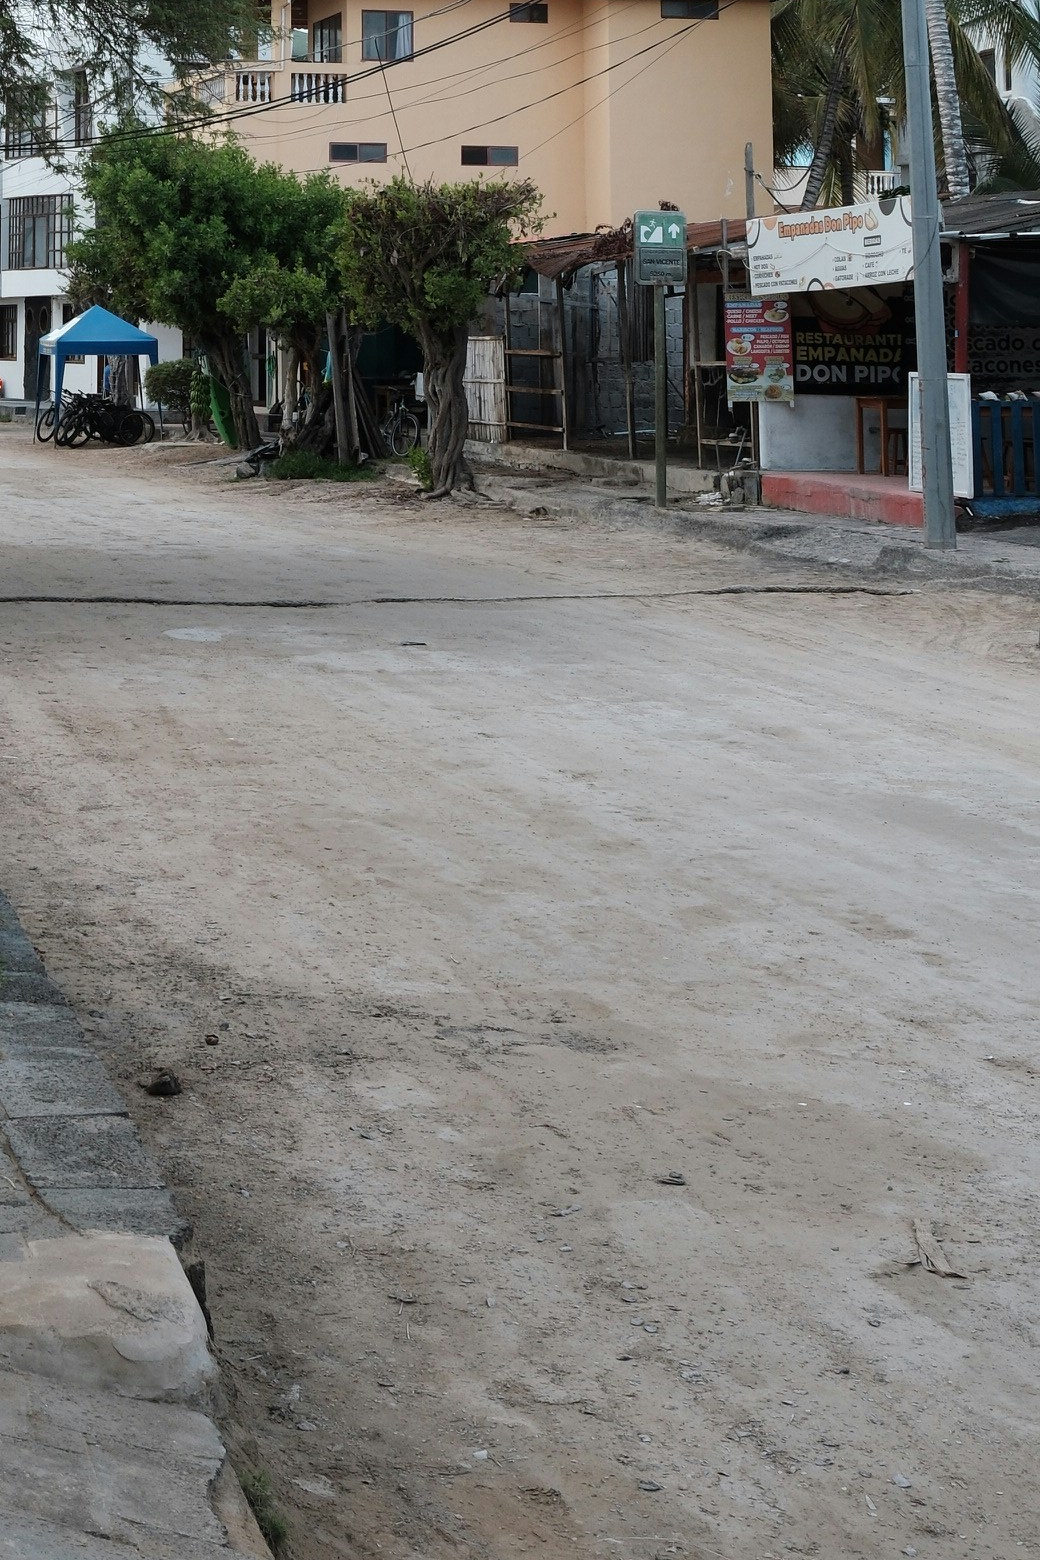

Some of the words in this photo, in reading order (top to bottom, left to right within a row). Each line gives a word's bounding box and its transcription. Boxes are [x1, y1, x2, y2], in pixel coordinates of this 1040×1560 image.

[778, 216, 823, 241] Empanadas
[824, 215, 842, 233] Don
[843, 211, 863, 234] Pipo
[796, 365, 847, 382] DON
